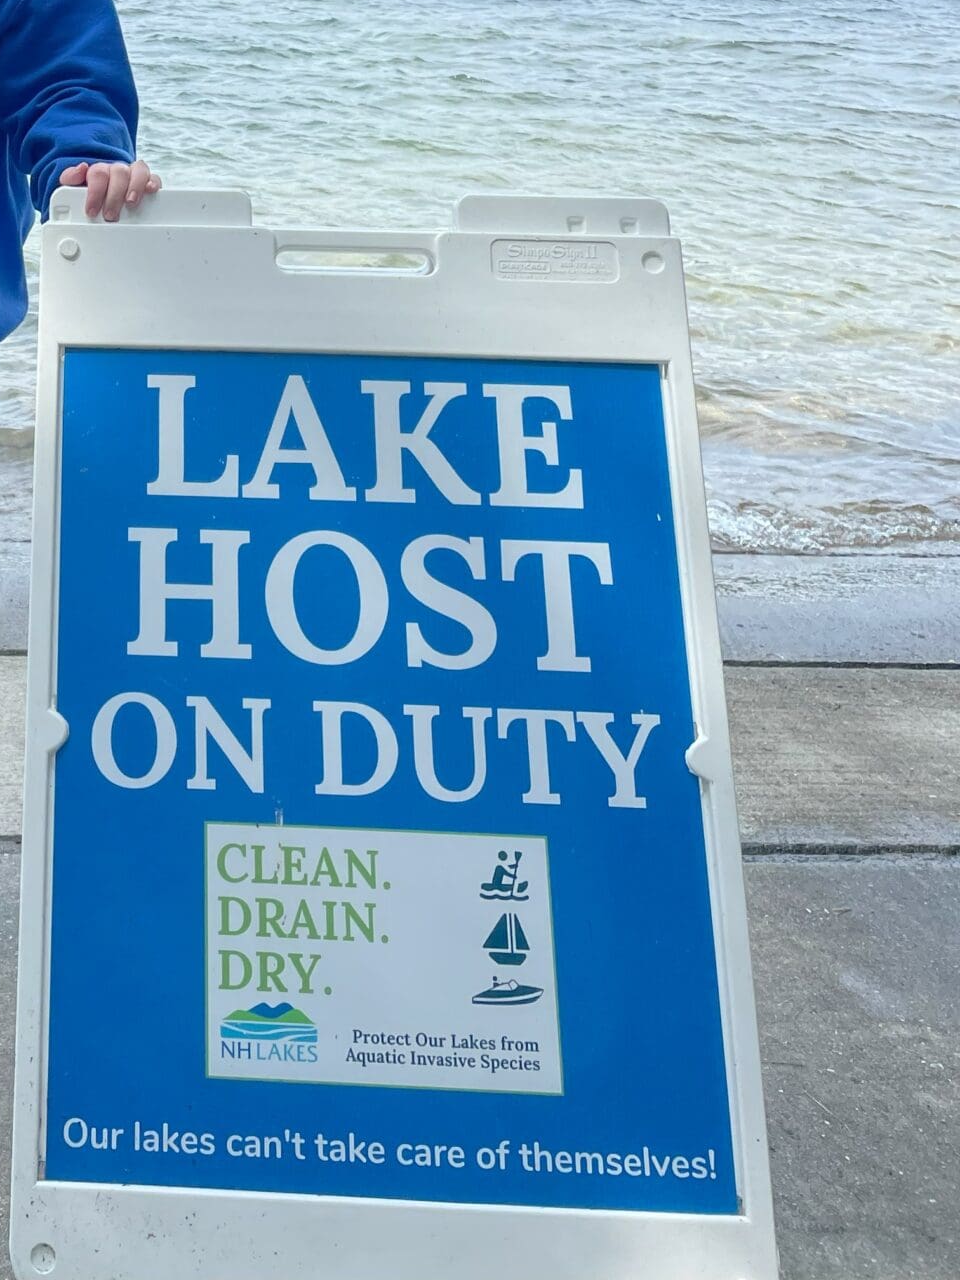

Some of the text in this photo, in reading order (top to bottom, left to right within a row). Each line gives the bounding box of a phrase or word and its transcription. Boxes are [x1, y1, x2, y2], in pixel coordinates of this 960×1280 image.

[146, 374, 585, 510] LAKE
[126, 527, 614, 673] HOST
[91, 691, 660, 809] ON DUTY
[216, 842, 391, 890] CLEAN.
[217, 895, 389, 944] DRAIN.
[218, 948, 332, 995] DRY.
[256, 1042, 318, 1063] LAKES
[345, 1048, 541, 1073] Aquatic Invasive Species
[352, 1029, 540, 1053] Protect Our Lakes from
[62, 1116, 718, 1180] Our lakes can't take care of themselves!
